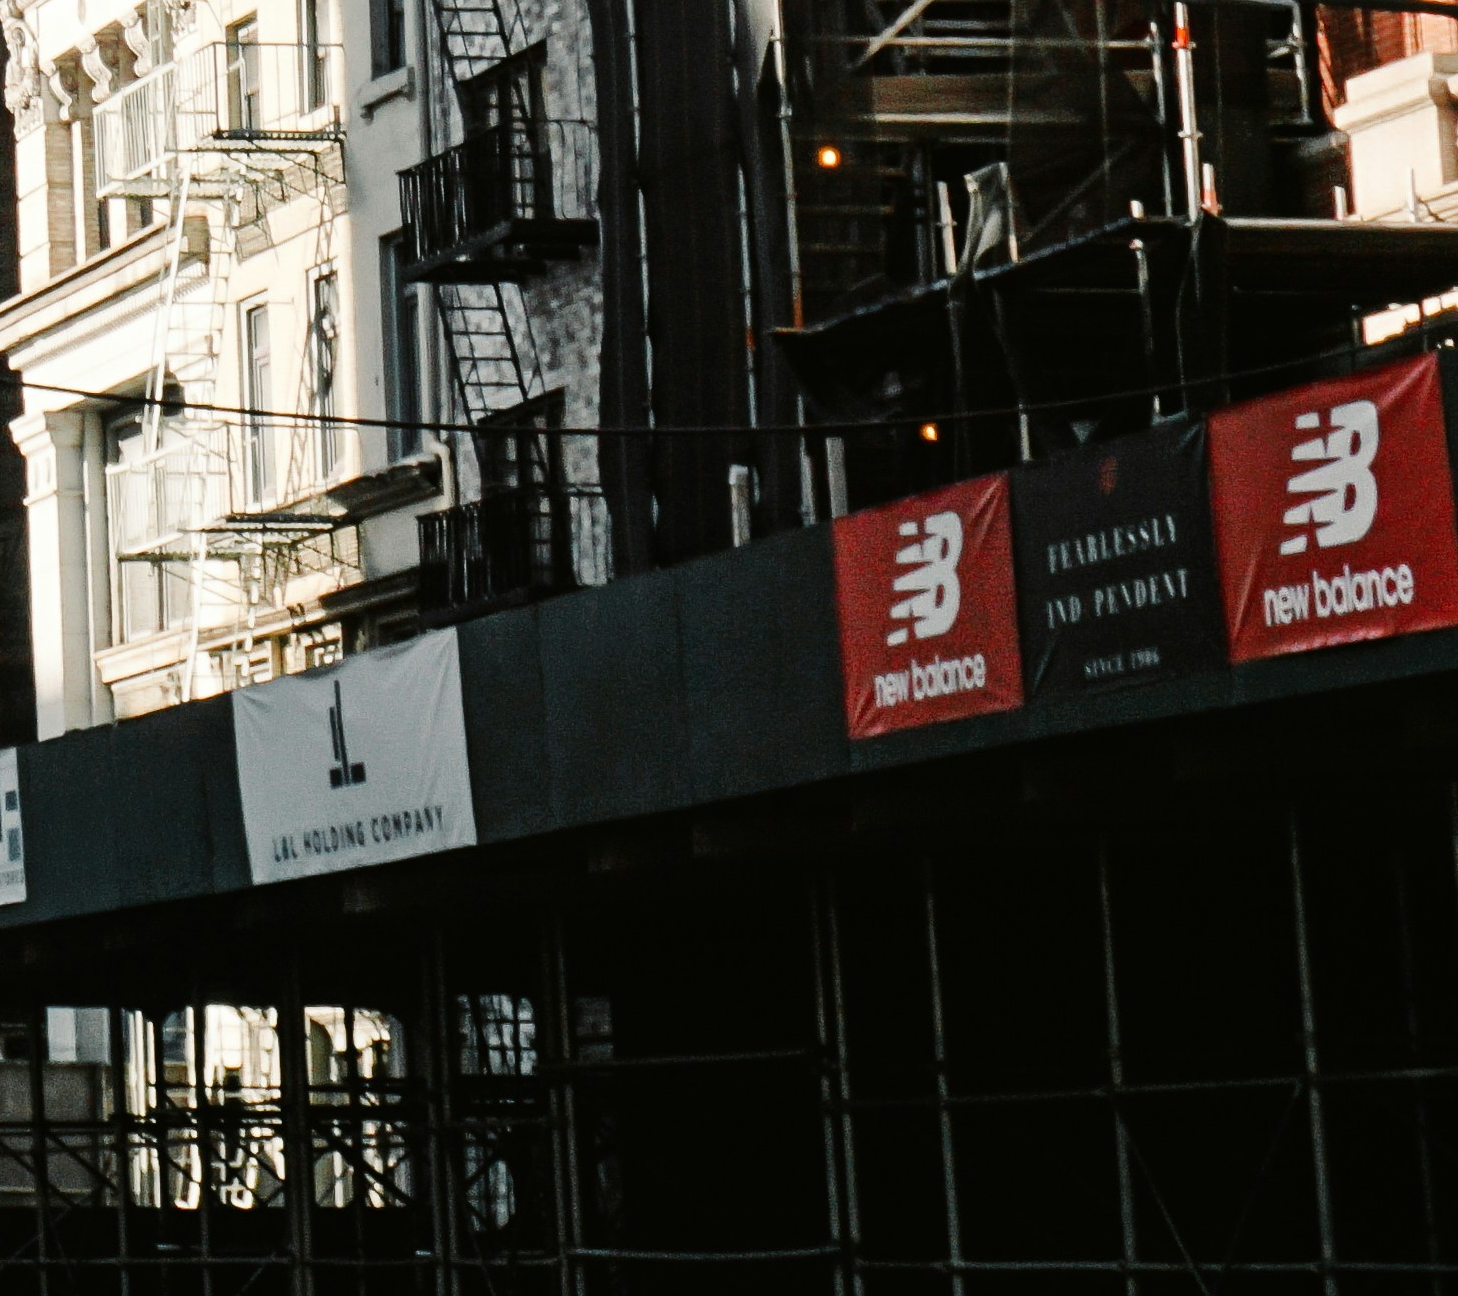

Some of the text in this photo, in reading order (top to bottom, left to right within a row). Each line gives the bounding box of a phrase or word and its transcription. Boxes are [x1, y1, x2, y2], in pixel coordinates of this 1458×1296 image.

[1047, 512, 1177, 574] FEARLESSLY
[1263, 563, 1414, 627] new balance
[874, 654, 986, 708] new balance
[304, 821, 365, 854] HOLDING
[371, 806, 443, 843] COMPANY
